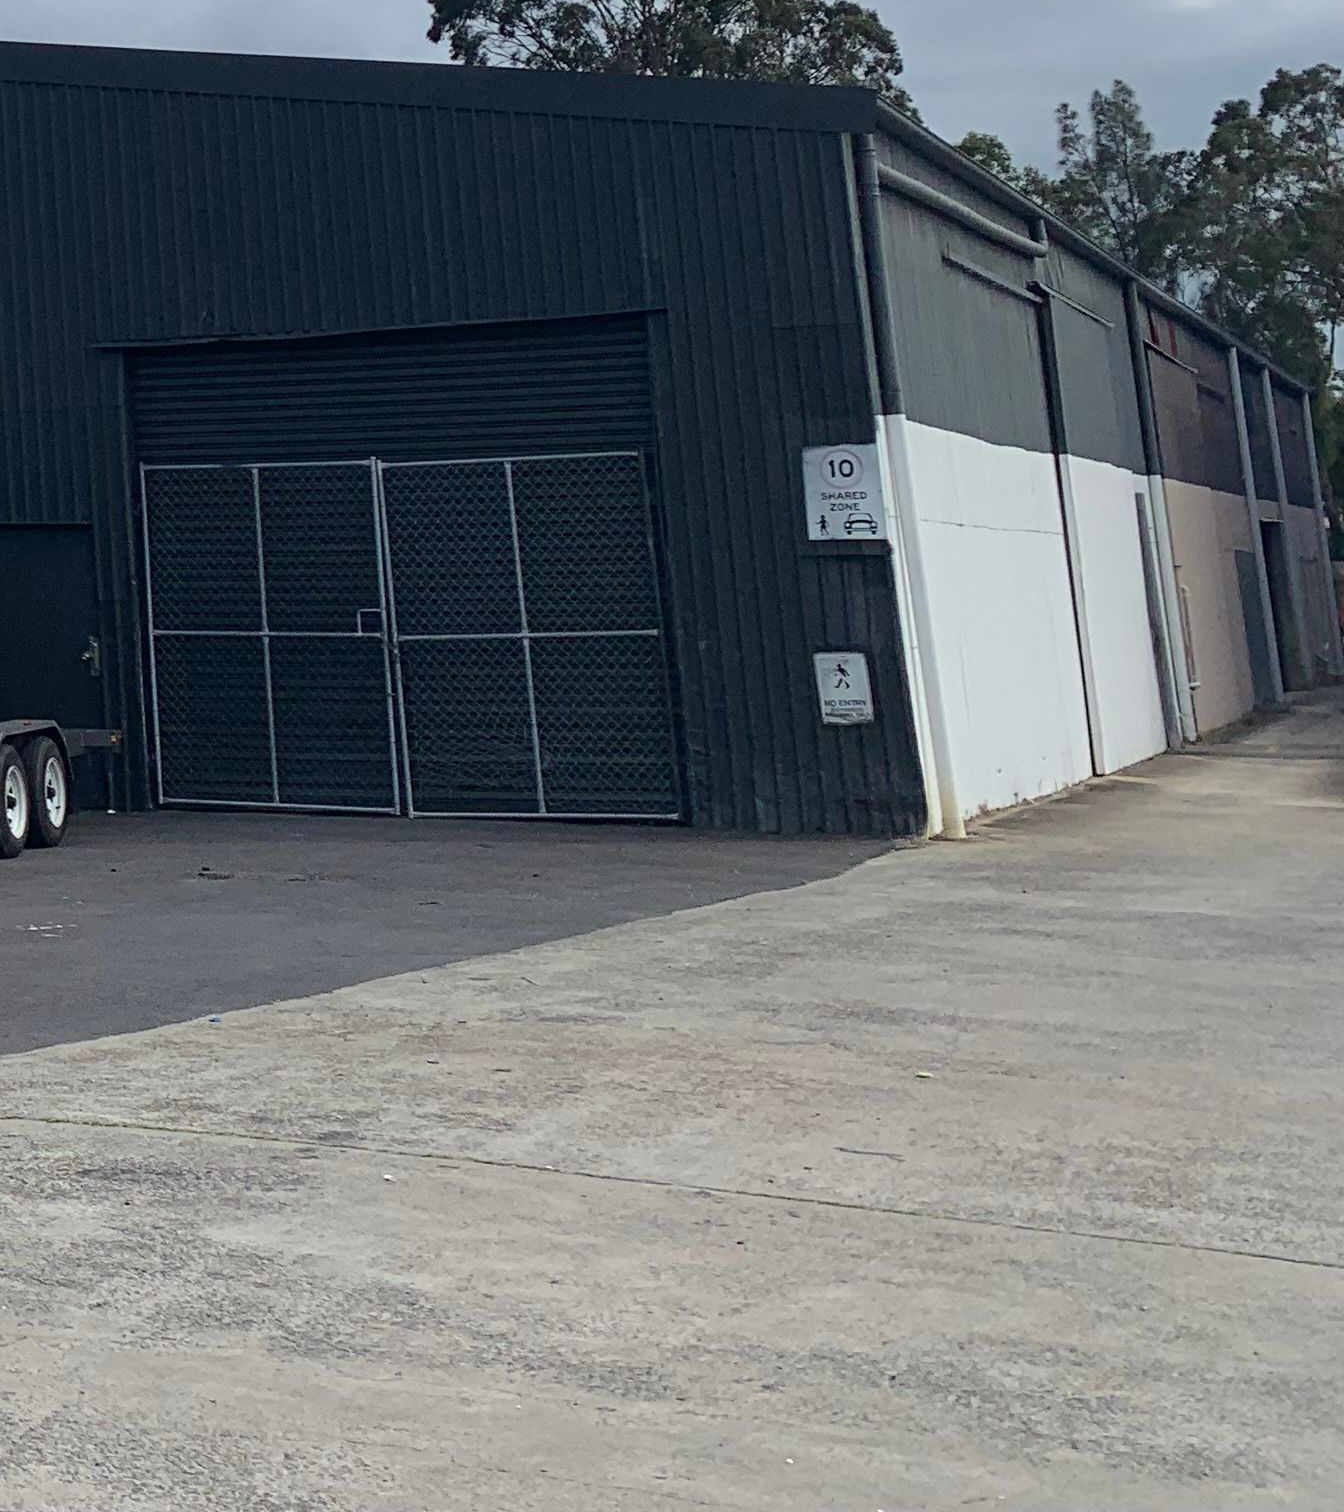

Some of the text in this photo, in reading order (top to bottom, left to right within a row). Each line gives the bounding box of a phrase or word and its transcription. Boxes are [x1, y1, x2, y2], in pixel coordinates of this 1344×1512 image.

[828, 459, 854, 478] 10
[820, 491, 867, 500] SHARED
[830, 503, 860, 511] ZONE
